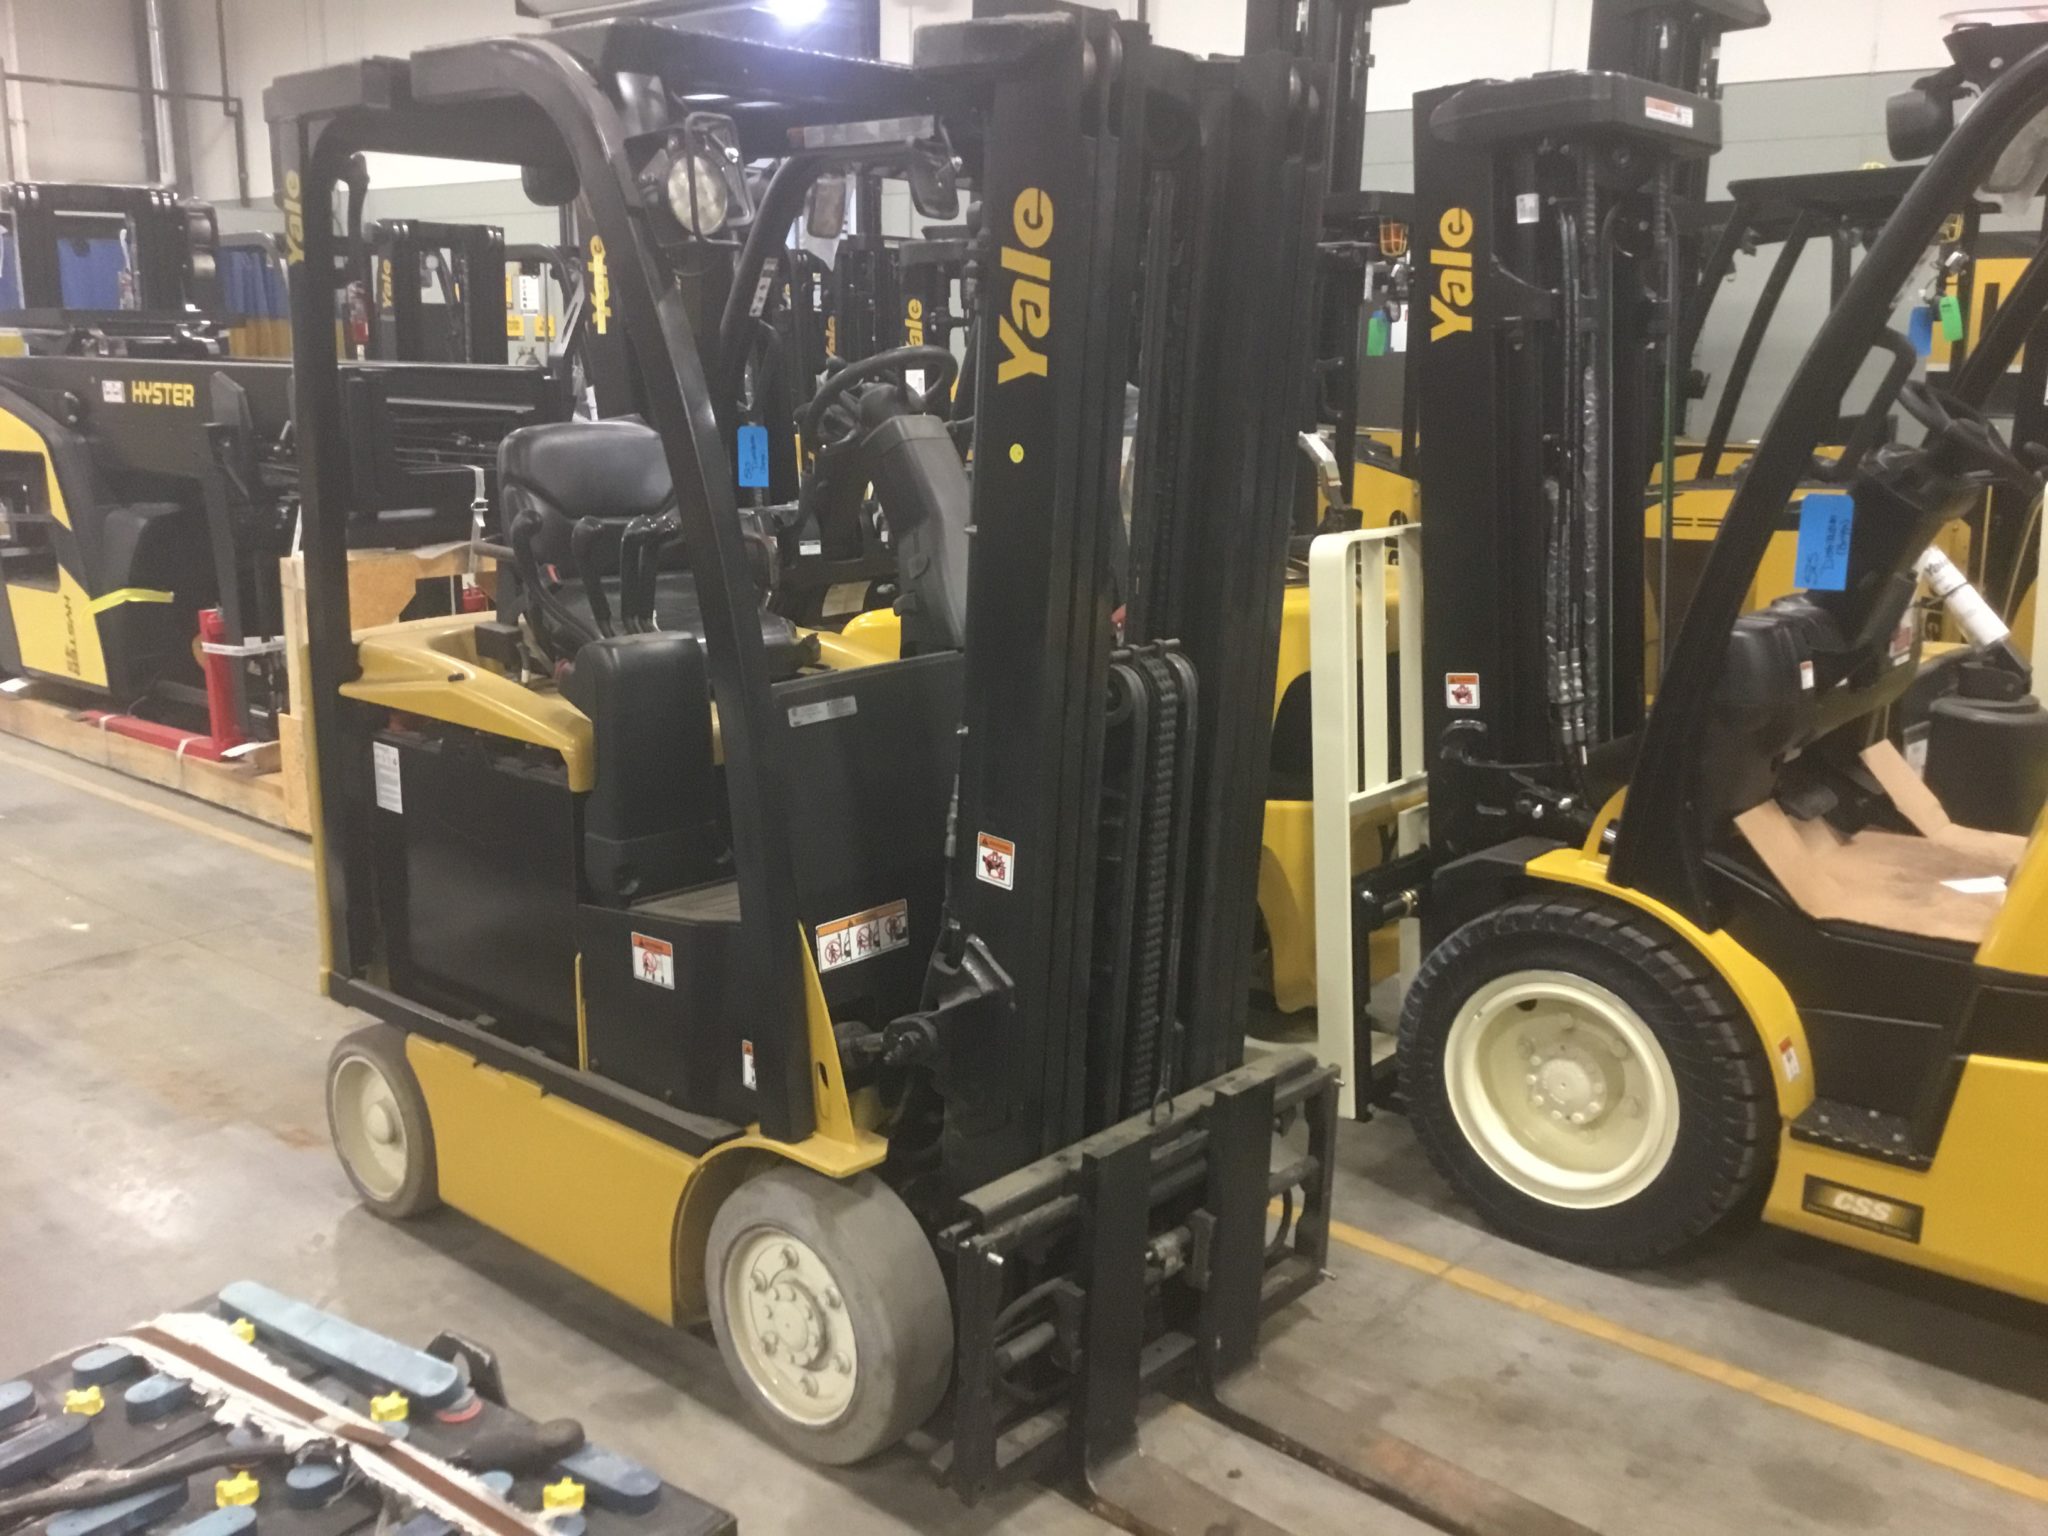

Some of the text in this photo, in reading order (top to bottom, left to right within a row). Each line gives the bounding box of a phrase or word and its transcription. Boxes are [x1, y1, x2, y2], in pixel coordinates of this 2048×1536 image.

[997, 187, 1054, 384] Yale
[1430, 207, 1474, 343] Yale
[905, 298, 924, 347] ale
[131, 381, 195, 407] HYSTER
[1833, 1191, 1892, 1222] CSS
